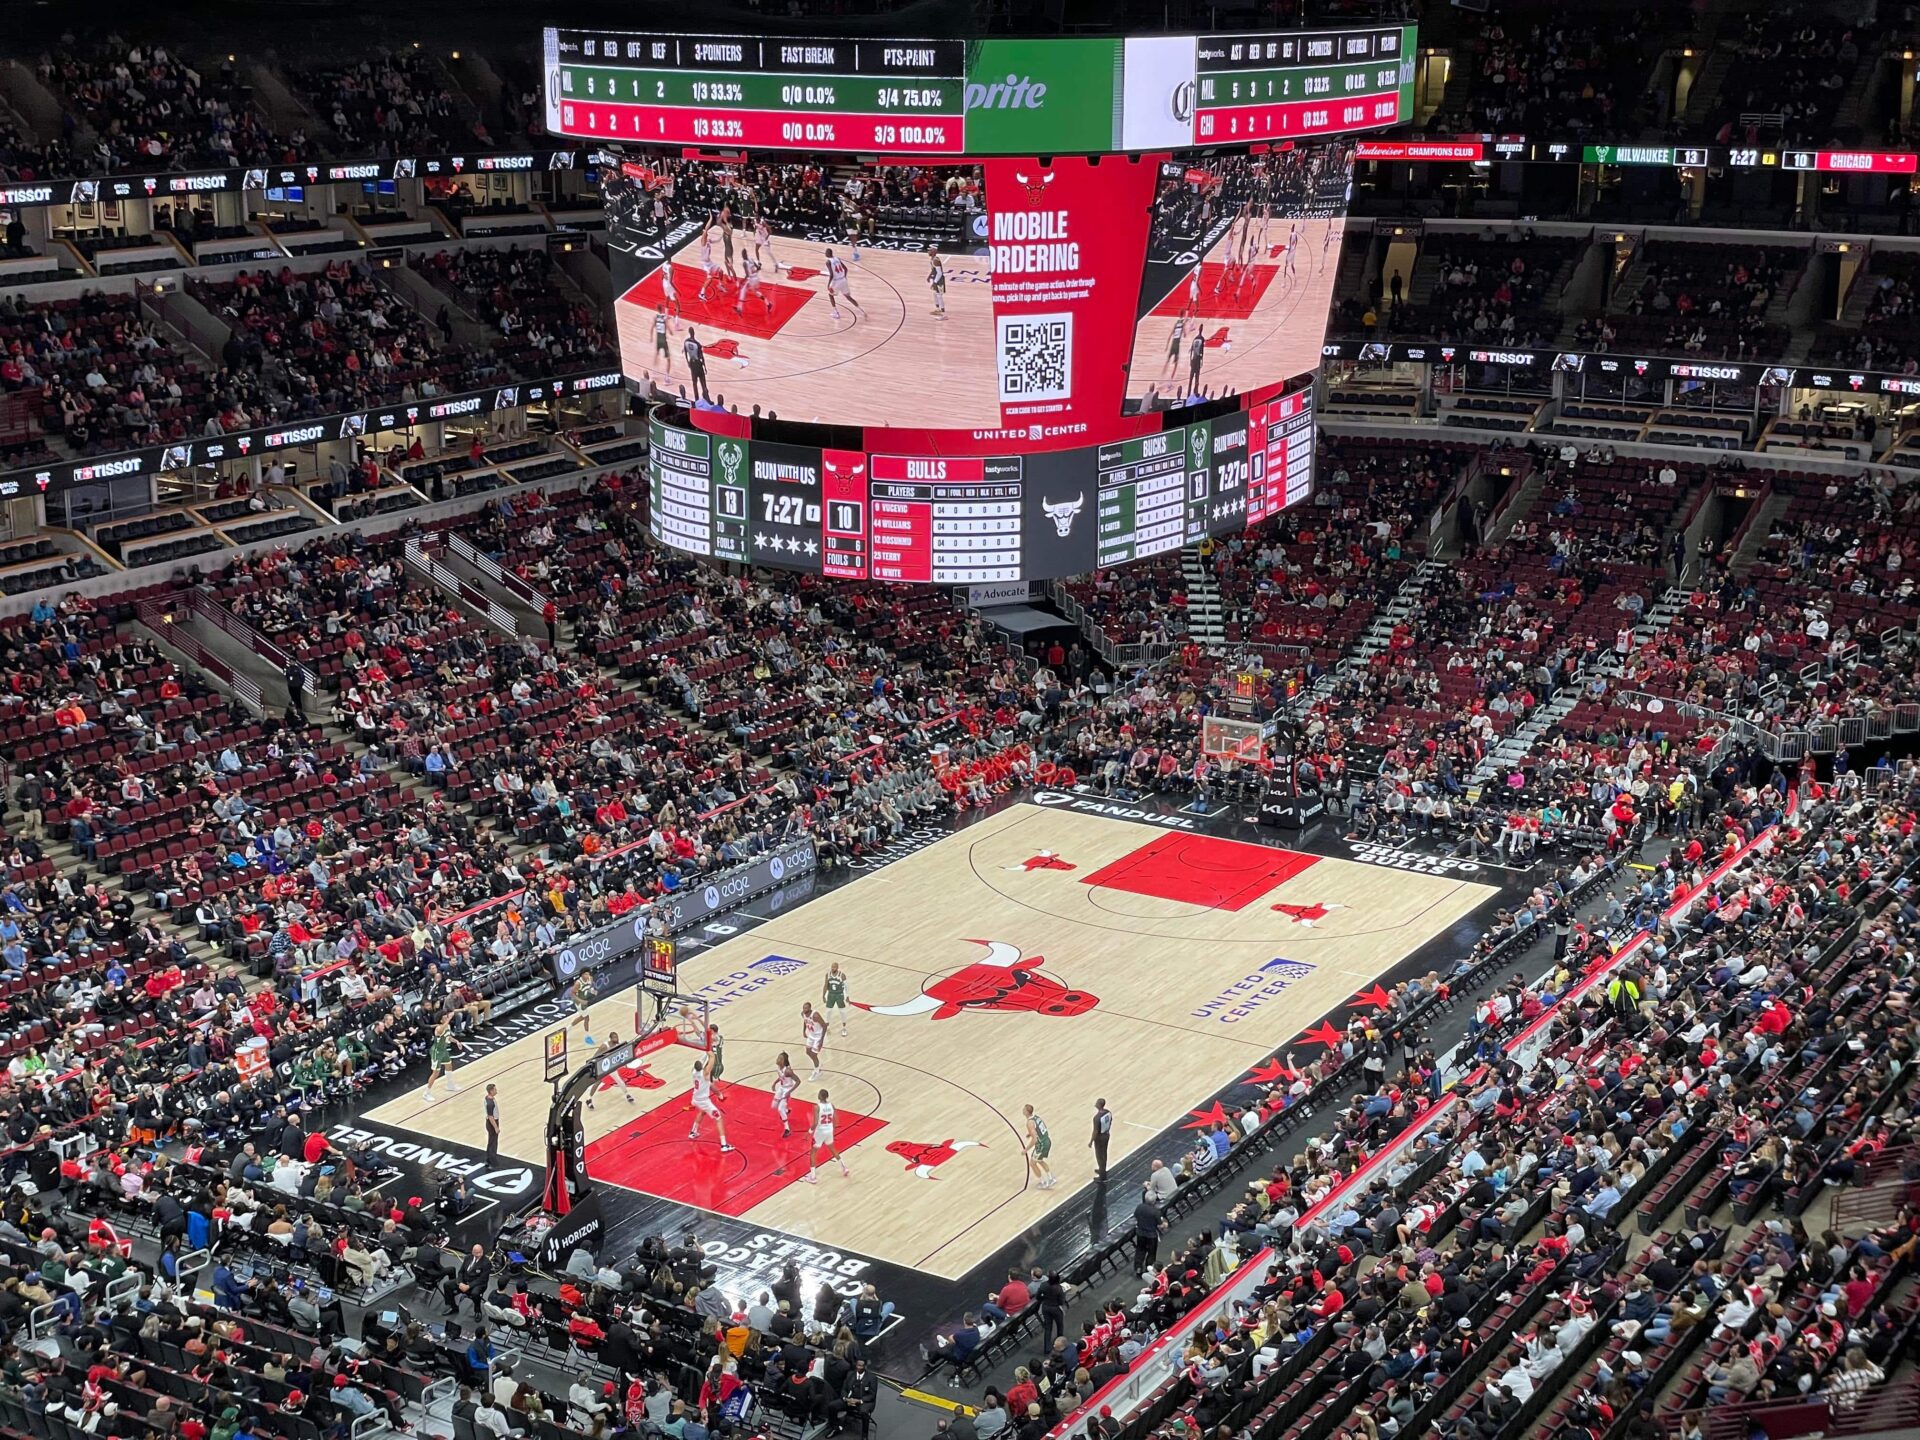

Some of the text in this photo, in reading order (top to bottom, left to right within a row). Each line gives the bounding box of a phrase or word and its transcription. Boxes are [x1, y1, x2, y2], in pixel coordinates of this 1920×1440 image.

[627, 42, 640, 58] OFF
[652, 43, 666, 59] DEF
[695, 44, 742, 62] 3-POINTERS
[781, 46, 835, 65] FAST BREAK
[884, 49, 936, 66] PTS-PAINT
[1231, 44, 1242, 61] AST
[588, 77, 594, 94] 5
[608, 79, 616, 95] 3
[632, 80, 638, 96] 1
[657, 81, 664, 97] 2
[692, 82, 708, 102] 1/3
[710, 84, 742, 101] 33.3%
[782, 85, 801, 105] 0/0
[805, 87, 835, 104] 0.0%
[878, 88, 898, 108] 3/4
[903, 89, 942, 107] 75.0%
[964, 74, 1047, 113] prite
[1201, 79, 1289, 100] MIL 5 3 2
[589, 113, 595, 129] 3
[610, 114, 617, 130] 2
[658, 117, 664, 134] 1
[693, 118, 708, 137] 1/3
[711, 120, 743, 137] 33.3%
[782, 122, 801, 142] 0/0
[805, 123, 835, 141] 0.0%
[874, 125, 895, 145] 3/3
[899, 126, 945, 144] 100.0%
[1200, 115, 1254, 135] CHI 3 2
[1356, 144, 1404, 157] Budweiser
[1408, 146, 1474, 157] CHAMPIONS CLUB
[1496, 144, 1523, 153] TIMEOUTS
[1549, 144, 1567, 153] FOULS
[1616, 147, 1669, 163] MILWAUKEE
[1684, 150, 1698, 164] 13
[493, 156, 534, 169] TISSOT
[1730, 150, 1757, 166] 7:27
[1794, 154, 1808, 167] 10
[1829, 154, 1873, 169] CHICAGO
[343, 165, 380, 180] TISSOT
[187, 175, 227, 190] TISSOT
[5, 188, 53, 203] TISSOT
[994, 210, 1068, 241] MOBILE
[1488, 352, 1534, 366] TISSOT
[587, 374, 621, 389] TISSOT
[1690, 366, 1741, 380] TISSOT
[1900, 381, 1920, 394] TIS
[445, 397, 482, 415] TISSOT
[289, 425, 324, 443] TISSOT
[974, 423, 1087, 440] UNITED CENTER
[664, 429, 686, 452] BUCKS
[1143, 435, 1167, 458] BUCKS
[93, 458, 142, 478] TISSOT
[755, 461, 816, 486] RUN WITH US
[907, 460, 946, 479] BULLS
[1218, 461, 1240, 492] 7:27
[888, 486, 915, 498] PLAYERS
[725, 491, 737, 515] 13
[762, 493, 803, 525] 7:27
[837, 505, 852, 529] 10
[873, 520, 882, 529] 44
[882, 520, 911, 530] WILLIAMS
[717, 537, 735, 550] FOULS
[827, 537, 836, 549] TO
[827, 553, 848, 566] FOULS
[882, 568, 901, 577] WHITE
[984, 586, 1025, 600] Advocate
[1070, 799, 1195, 829] FANDUEL
[847, 826, 943, 868] CALAMOS
[786, 847, 813, 869] edge
[1349, 843, 1480, 872] CHICAGO
[1354, 852, 1449, 876] BULLS
[721, 875, 749, 898] edge
[578, 937, 611, 962] edge
[652, 940, 672, 954] 7:27
[1191, 974, 1264, 1018] UNITED
[1219, 980, 1292, 1023] CENTER
[459, 1007, 576, 1062] INVESTMENT
[612, 1049, 629, 1065] edge
[281, 1063, 292, 1075] G
[196, 1097, 207, 1110] G
[820, 1114, 833, 1124] 25
[328, 1124, 486, 1180] FANDUEL
[562, 1219, 599, 1248] HORIZON
[745, 1234, 871, 1277] BULLS
